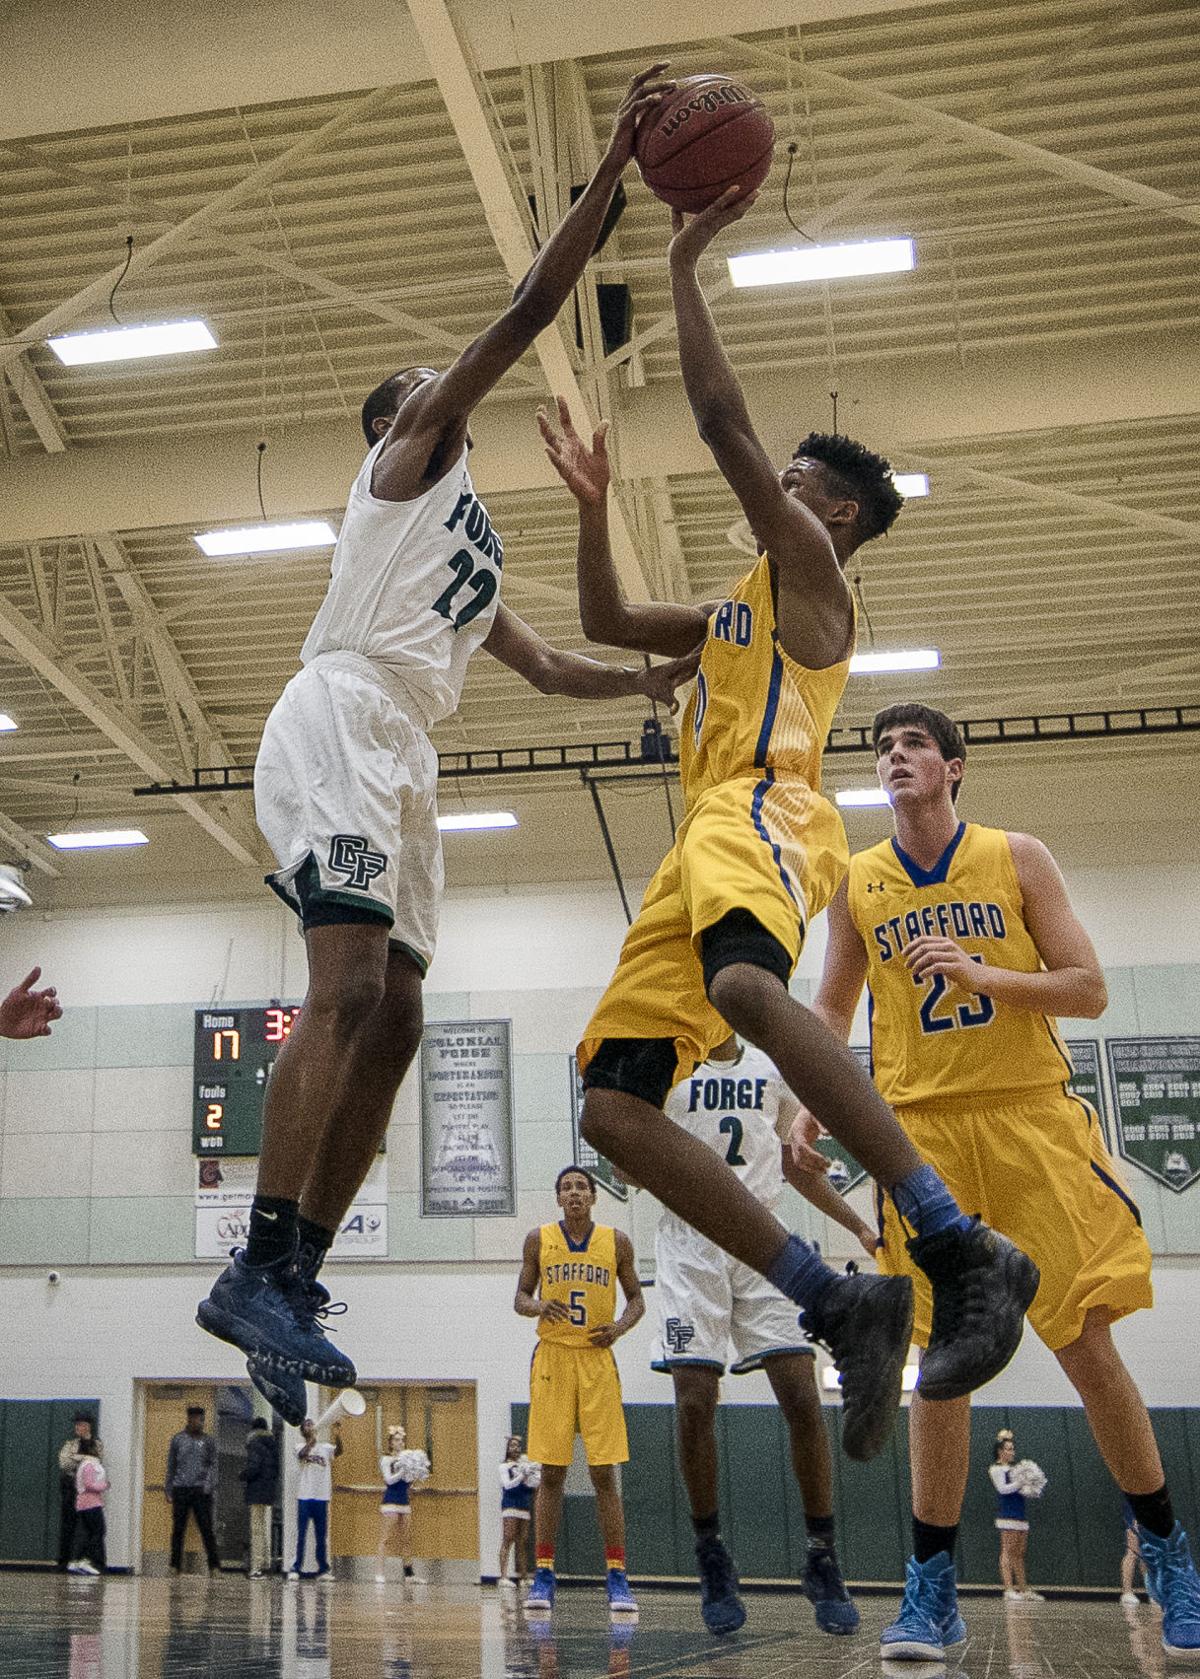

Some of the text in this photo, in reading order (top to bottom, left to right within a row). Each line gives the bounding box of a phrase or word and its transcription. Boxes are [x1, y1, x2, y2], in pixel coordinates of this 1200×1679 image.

[660, 84, 748, 137] Wilson
[442, 491, 503, 571] FORG
[431, 548, 497, 633] 22
[328, 833, 388, 891] CF
[873, 901, 1007, 963] STAFFORD
[203, 1013, 235, 1029] Home
[265, 1009, 300, 1041] 3:
[213, 1030, 240, 1061] 17
[688, 1078, 768, 1112] FORGE
[206, 1103, 223, 1129] 2
[719, 1116, 747, 1166] 2
[545, 1263, 610, 1288] STAFFORD
[569, 1290, 586, 1326] 5
